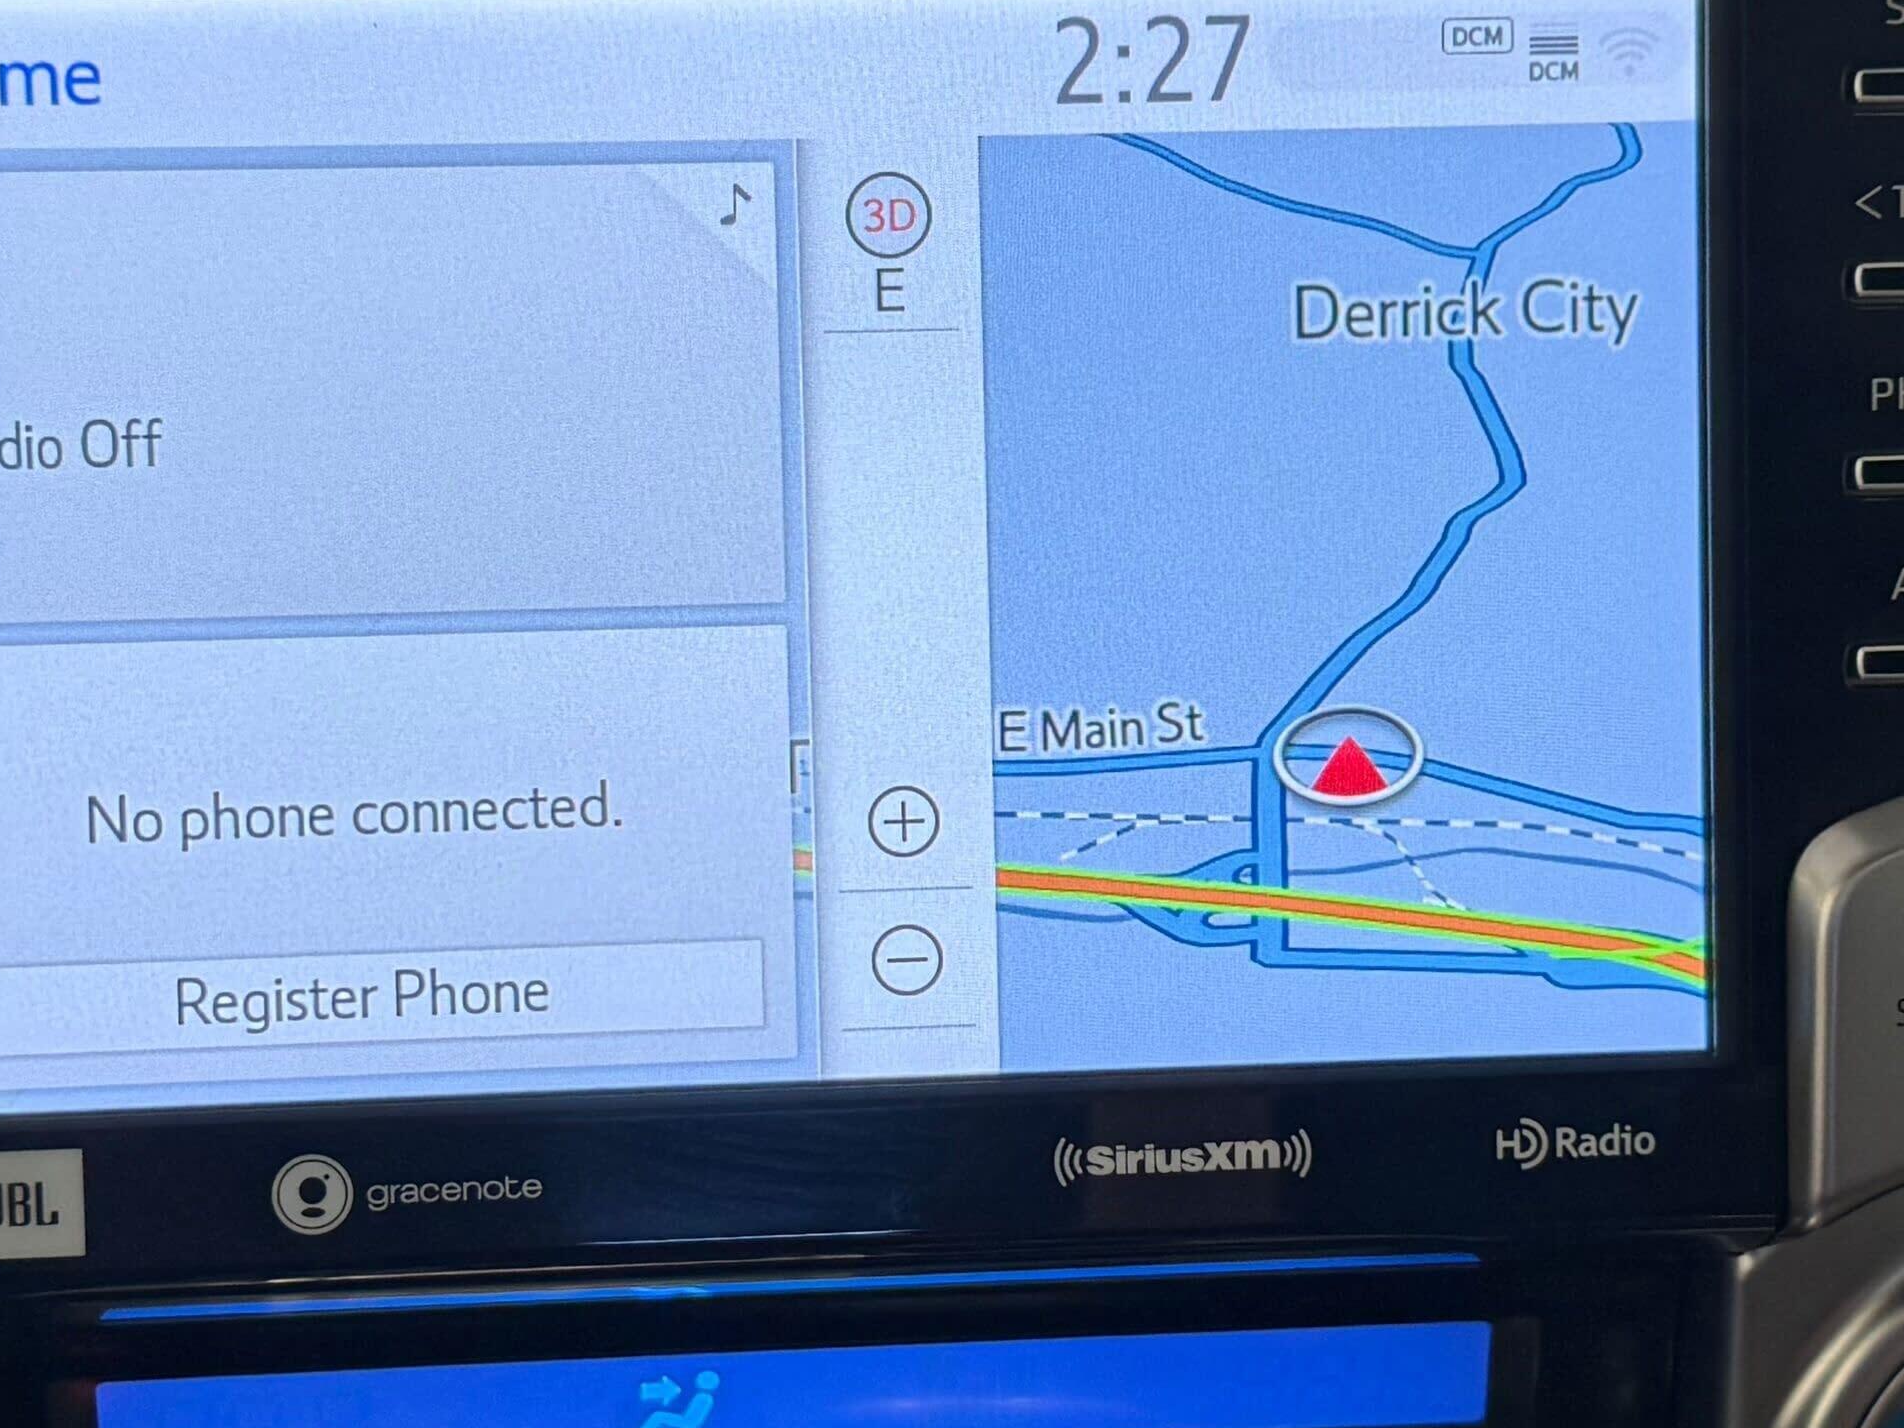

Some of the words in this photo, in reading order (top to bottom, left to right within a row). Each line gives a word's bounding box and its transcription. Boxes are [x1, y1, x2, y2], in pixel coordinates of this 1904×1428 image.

[1054, 13, 1252, 105] 2:27
[1451, 24, 1505, 49] DCM
[1527, 60, 1581, 83] DCM
[862, 197, 918, 234] 3D
[875, 267, 906, 313] E
[1294, 278, 1500, 342] Derrick
[1521, 278, 1640, 347] City
[80, 417, 164, 469] Off
[999, 710, 1029, 752] E
[1041, 707, 1145, 751] Main
[1156, 700, 1204, 744] St
[87, 794, 164, 844] No
[180, 790, 336, 853] phone
[351, 778, 625, 836] connected.
[174, 976, 380, 1035] Register
[393, 968, 551, 1019] Phone
[1555, 1123, 1657, 1159] Radio
[365, 1174, 544, 1212] gracenote
